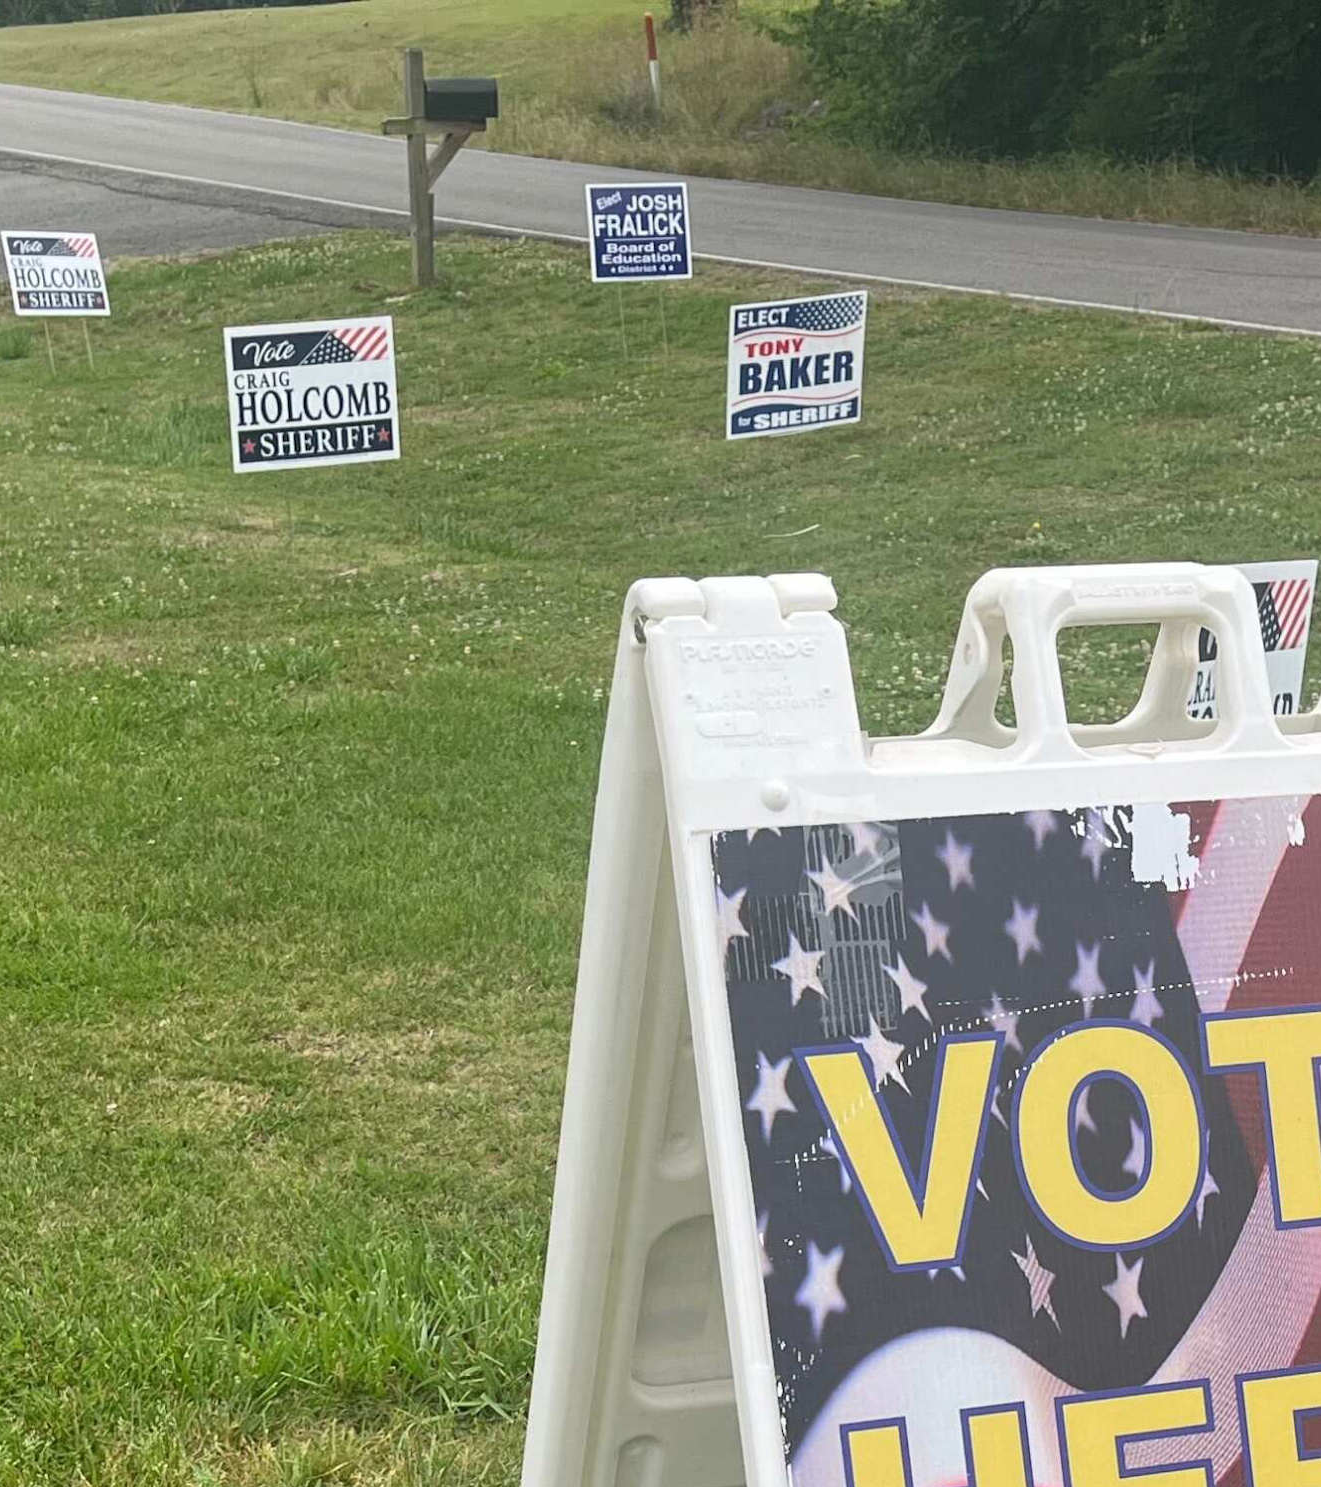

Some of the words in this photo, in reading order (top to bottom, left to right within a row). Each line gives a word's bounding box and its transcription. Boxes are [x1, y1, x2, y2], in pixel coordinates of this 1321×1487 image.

[596, 191, 622, 210] Elect
[626, 194, 683, 212] JOSH
[594, 212, 684, 237] FRALICK
[13, 240, 44, 254] Vote
[606, 242, 655, 254] Board
[658, 241, 675, 252] of
[601, 253, 682, 265] Education
[618, 265, 657, 273] District
[659, 264, 666, 272] 4
[14, 268, 102, 289] HOLCOMB
[29, 292, 96, 308] SHERIFF
[737, 307, 790, 328] ELECT
[242, 340, 295, 367] Vote
[745, 338, 804, 358] TONY
[234, 371, 290, 390] CRAIG
[739, 351, 853, 395] BAKER
[236, 381, 391, 426] HOLCOMB
[753, 402, 853, 430] SHERIFF
[259, 424, 375, 458] SHERIFF
